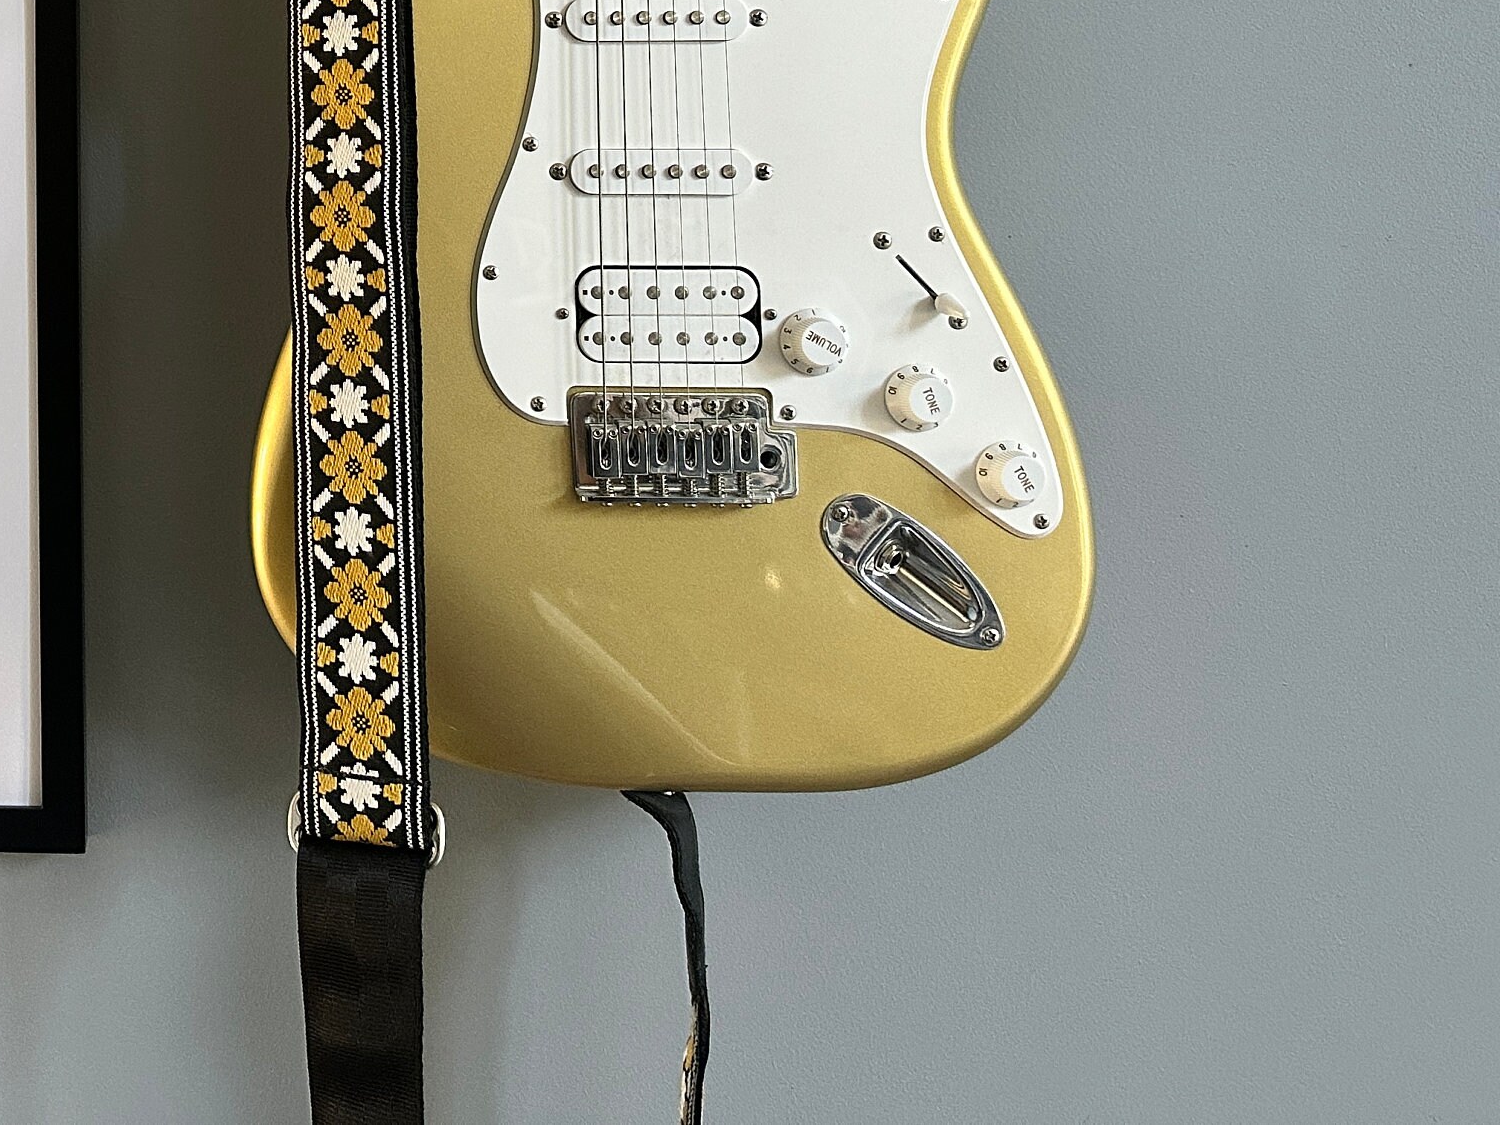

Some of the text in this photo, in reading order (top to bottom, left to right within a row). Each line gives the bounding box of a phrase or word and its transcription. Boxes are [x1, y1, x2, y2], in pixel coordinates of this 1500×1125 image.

[805, 330, 842, 357] VOLUME
[922, 386, 941, 415] TONE
[1014, 465, 1035, 494] TONE
